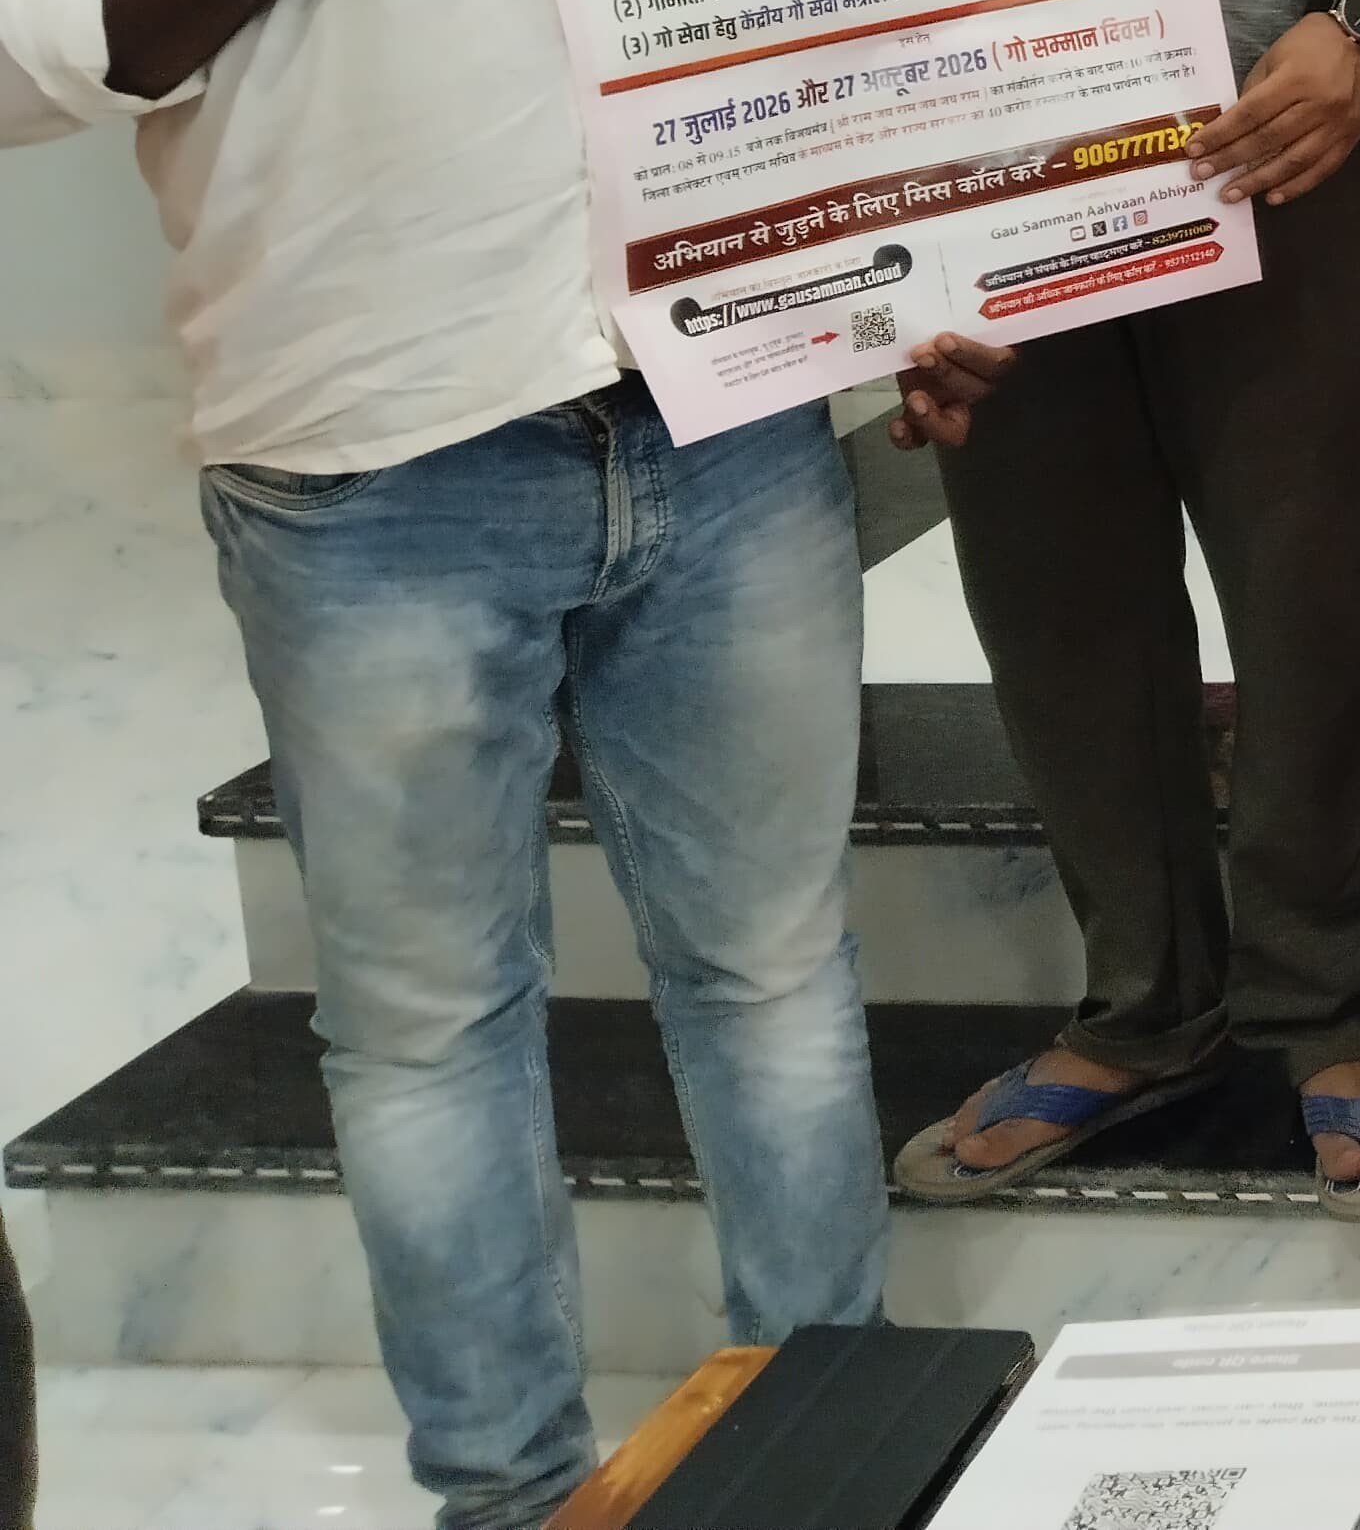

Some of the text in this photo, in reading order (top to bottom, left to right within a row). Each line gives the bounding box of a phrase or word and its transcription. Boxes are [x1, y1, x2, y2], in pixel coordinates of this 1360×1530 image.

[622, 31, 649, 60] (3)
[652, 25, 673, 48] गो
[675, 21, 710, 44] सेवा
[711, 15, 738, 40] हेतु
[738, 5, 783, 30] केंद्रीय
[652, 16, 1149, 146] 27 जुलाई 2026 और 27 अक्टूबर 2026 गो सम्मान दिवस
[653, 232, 745, 270] अभियान
[747, 220, 771, 245] से
[773, 206, 827, 246] जुड़ने
[826, 199, 850, 223] के
[852, 187, 902, 219] लिए
[900, 179, 951, 207] मिस
[955, 164, 1005, 194] कॉल
[1006, 155, 1046, 182] करें
[990, 176, 1205, 240] Gau Samman Aahvaan Abhiyan
[683, 261, 905, 340] https://www.gausamman.cloud
